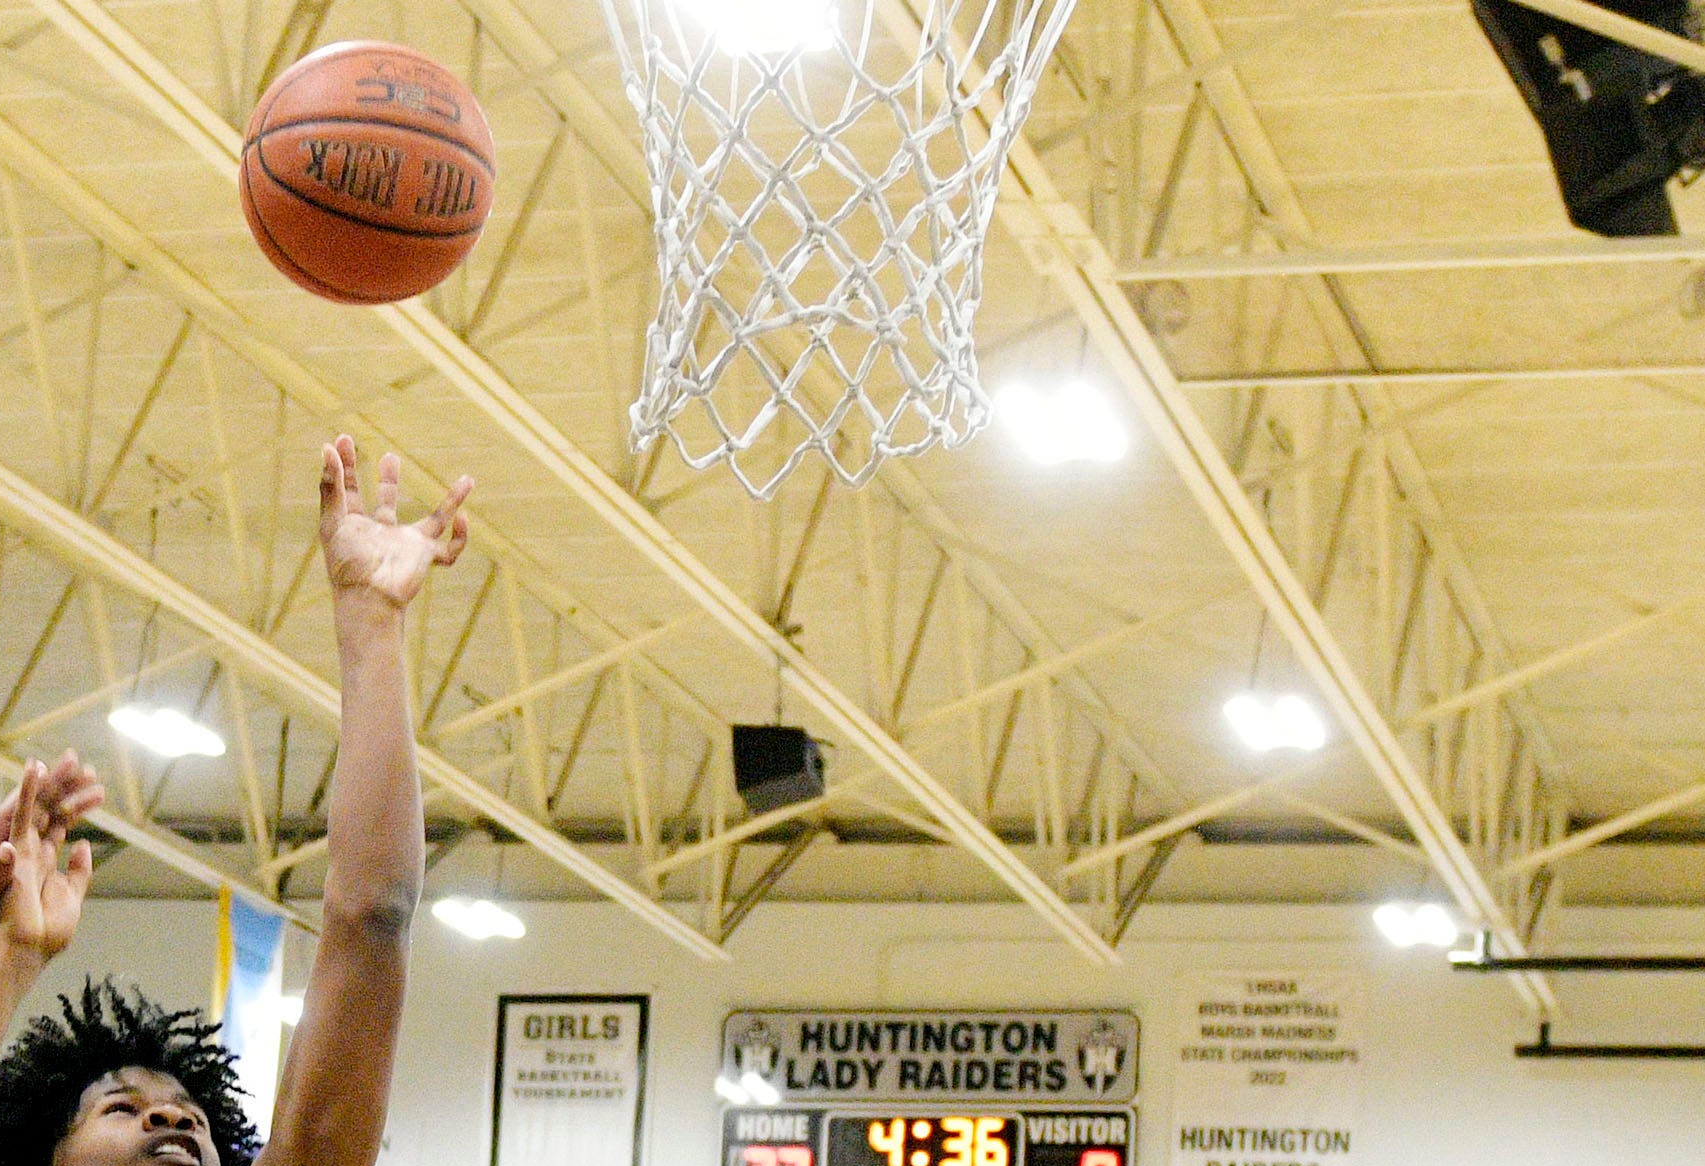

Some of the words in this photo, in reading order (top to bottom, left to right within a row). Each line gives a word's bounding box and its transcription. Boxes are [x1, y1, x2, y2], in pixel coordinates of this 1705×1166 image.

[301, 139, 406, 210] ROCK
[415, 158, 477, 218] THE
[523, 1014, 621, 1040] GIRLS
[800, 1021, 1057, 1055] HUNTINGTON
[786, 1060, 885, 1091] LADY
[899, 1060, 1067, 1092] RAIDERS
[737, 1115, 809, 1141] HOME
[1028, 1118, 1127, 1144] VISITOR
[1180, 1126, 1351, 1154] HUNTINGTON
